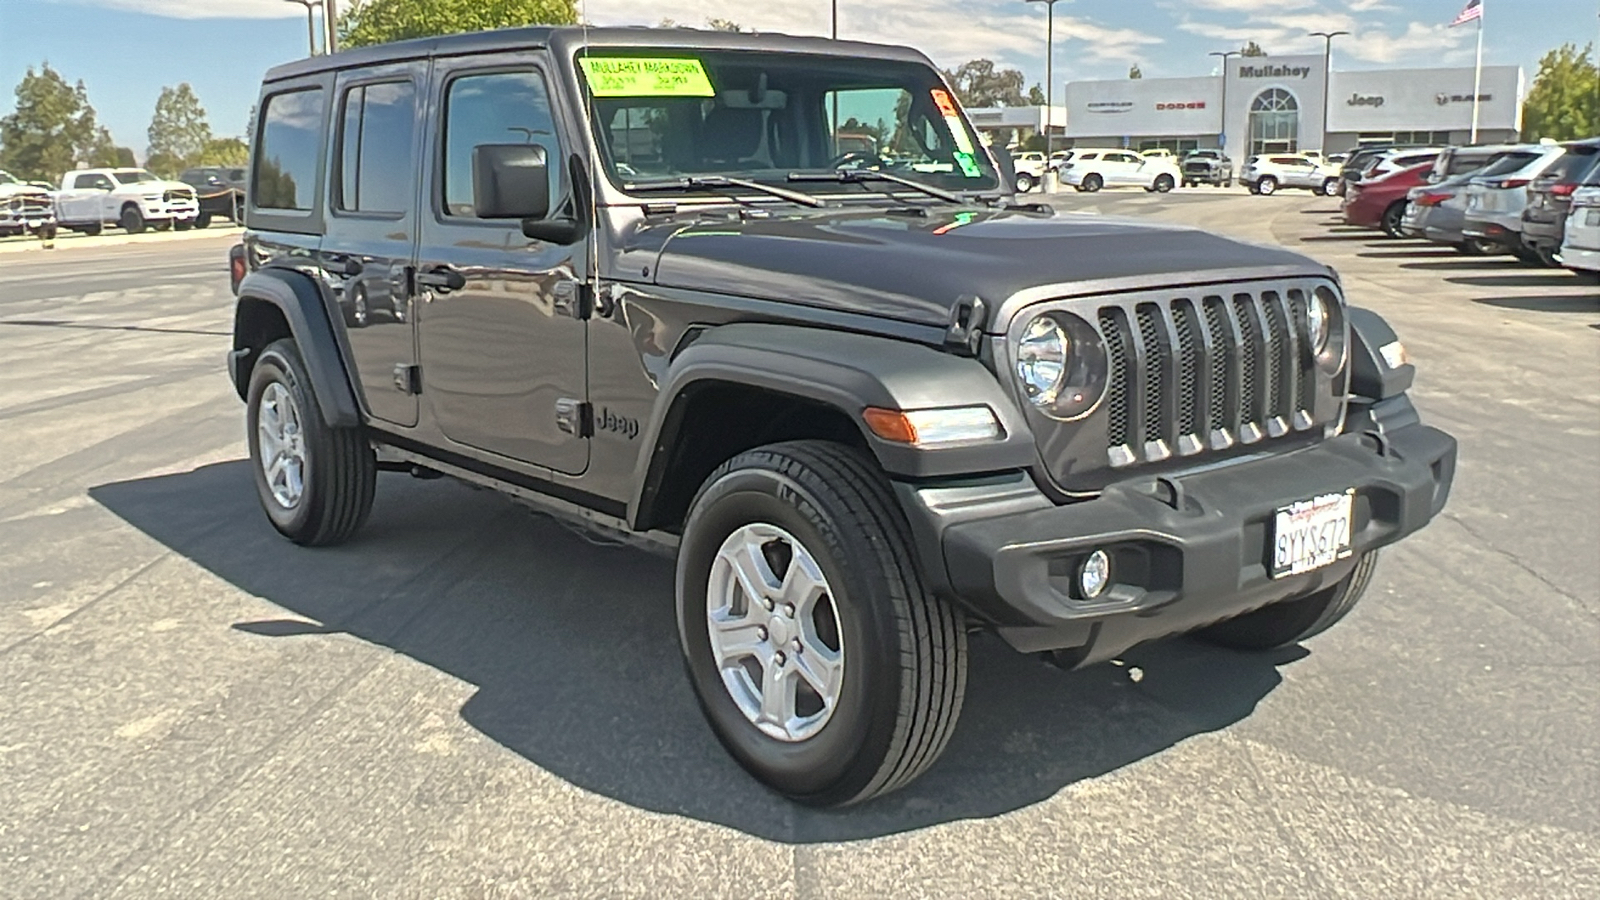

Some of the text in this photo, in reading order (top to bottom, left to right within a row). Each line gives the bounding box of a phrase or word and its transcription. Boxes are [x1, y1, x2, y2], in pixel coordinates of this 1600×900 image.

[1239, 64, 1311, 79] Mullahey
[1156, 101, 1206, 110] DODGE
[1347, 93, 1385, 107] Jeep
[596, 406, 639, 440] Jeep
[1277, 516, 1347, 565] 8YYS672
